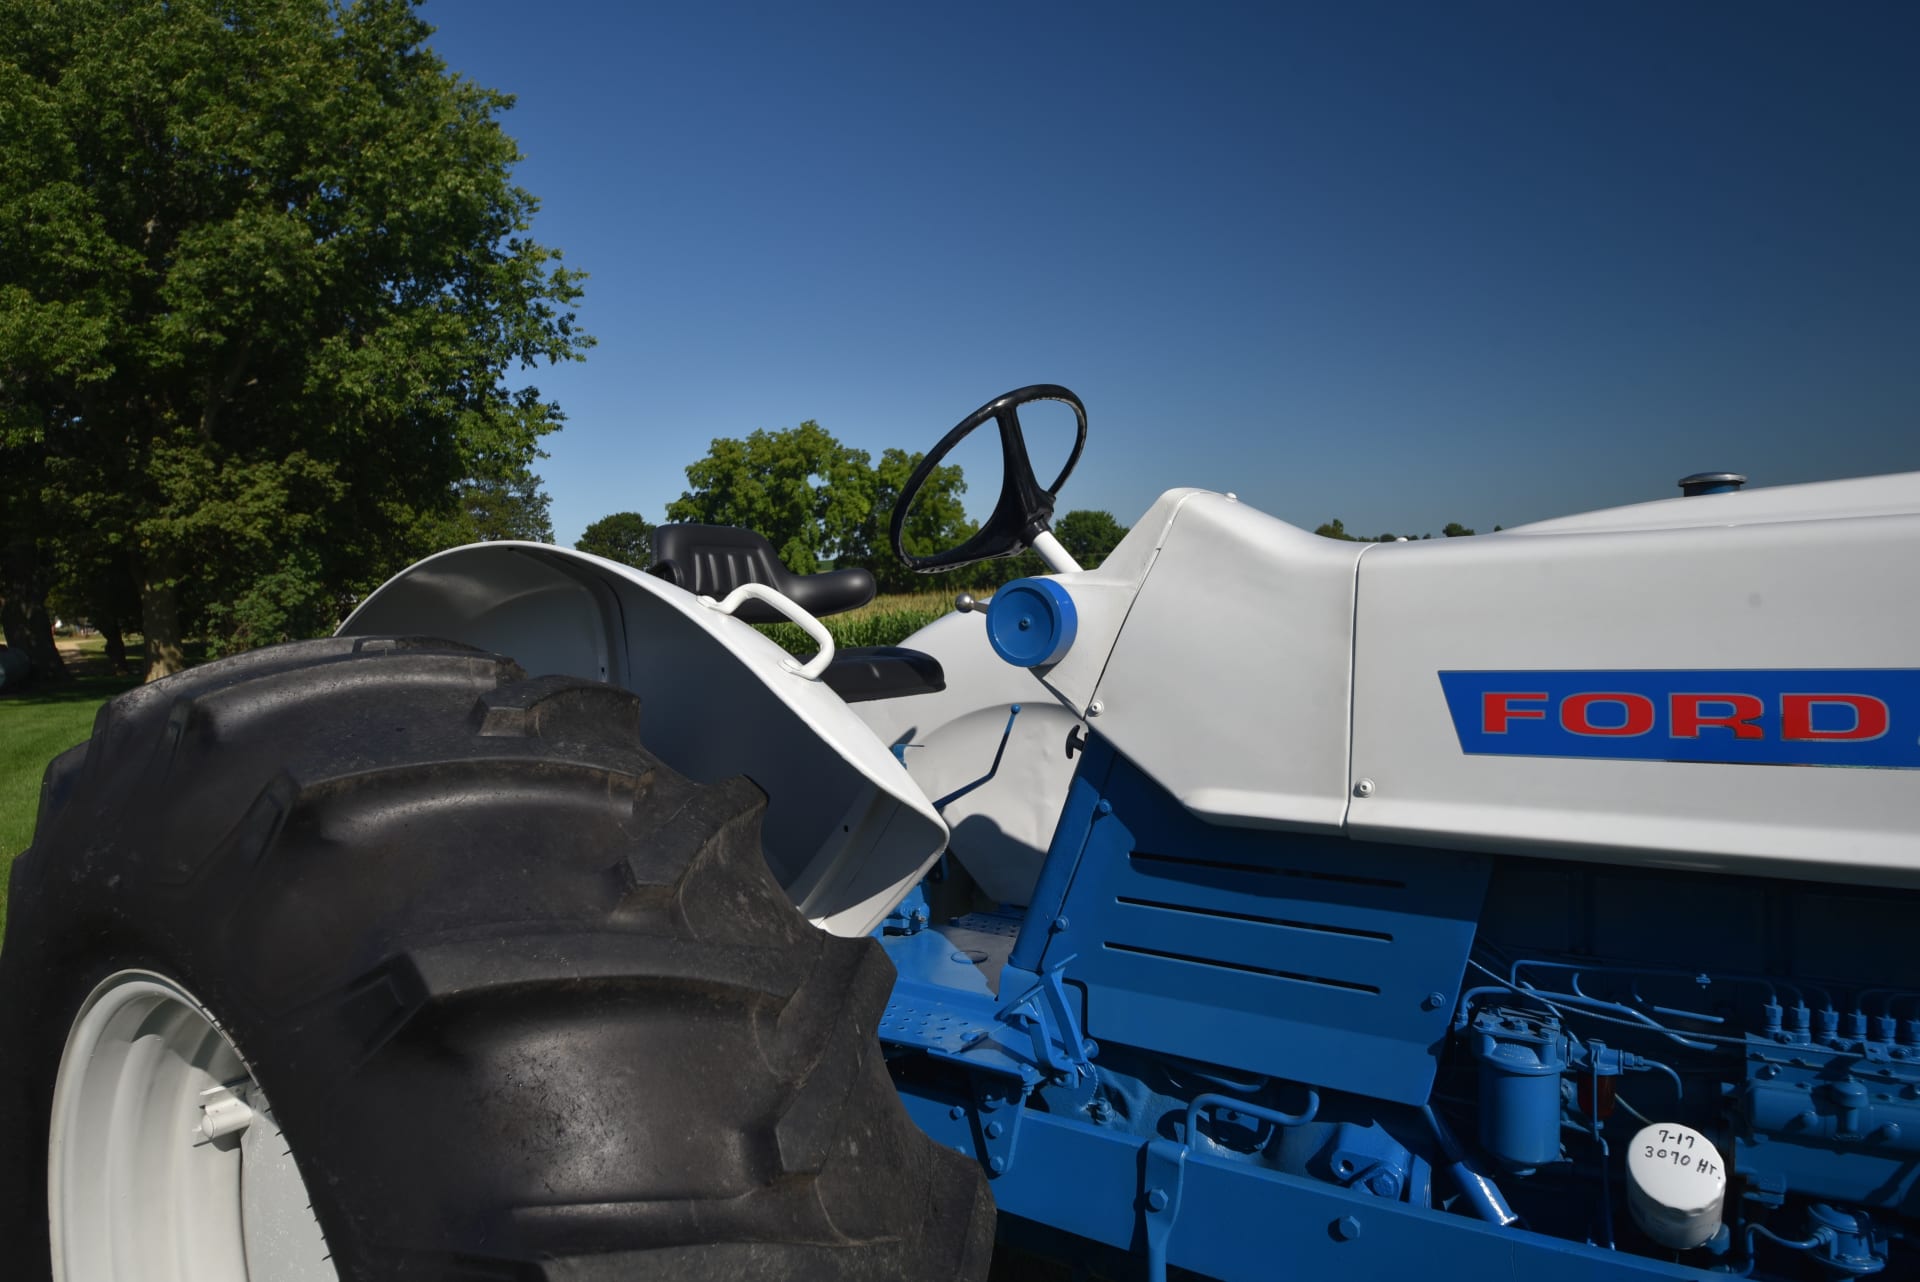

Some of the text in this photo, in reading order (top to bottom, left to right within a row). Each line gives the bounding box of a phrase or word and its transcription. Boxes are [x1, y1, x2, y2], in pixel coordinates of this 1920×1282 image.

[1481, 691, 1890, 742] FORD
[1659, 1129, 1695, 1149] 7-17
[1644, 1145, 1691, 1166] 3070
